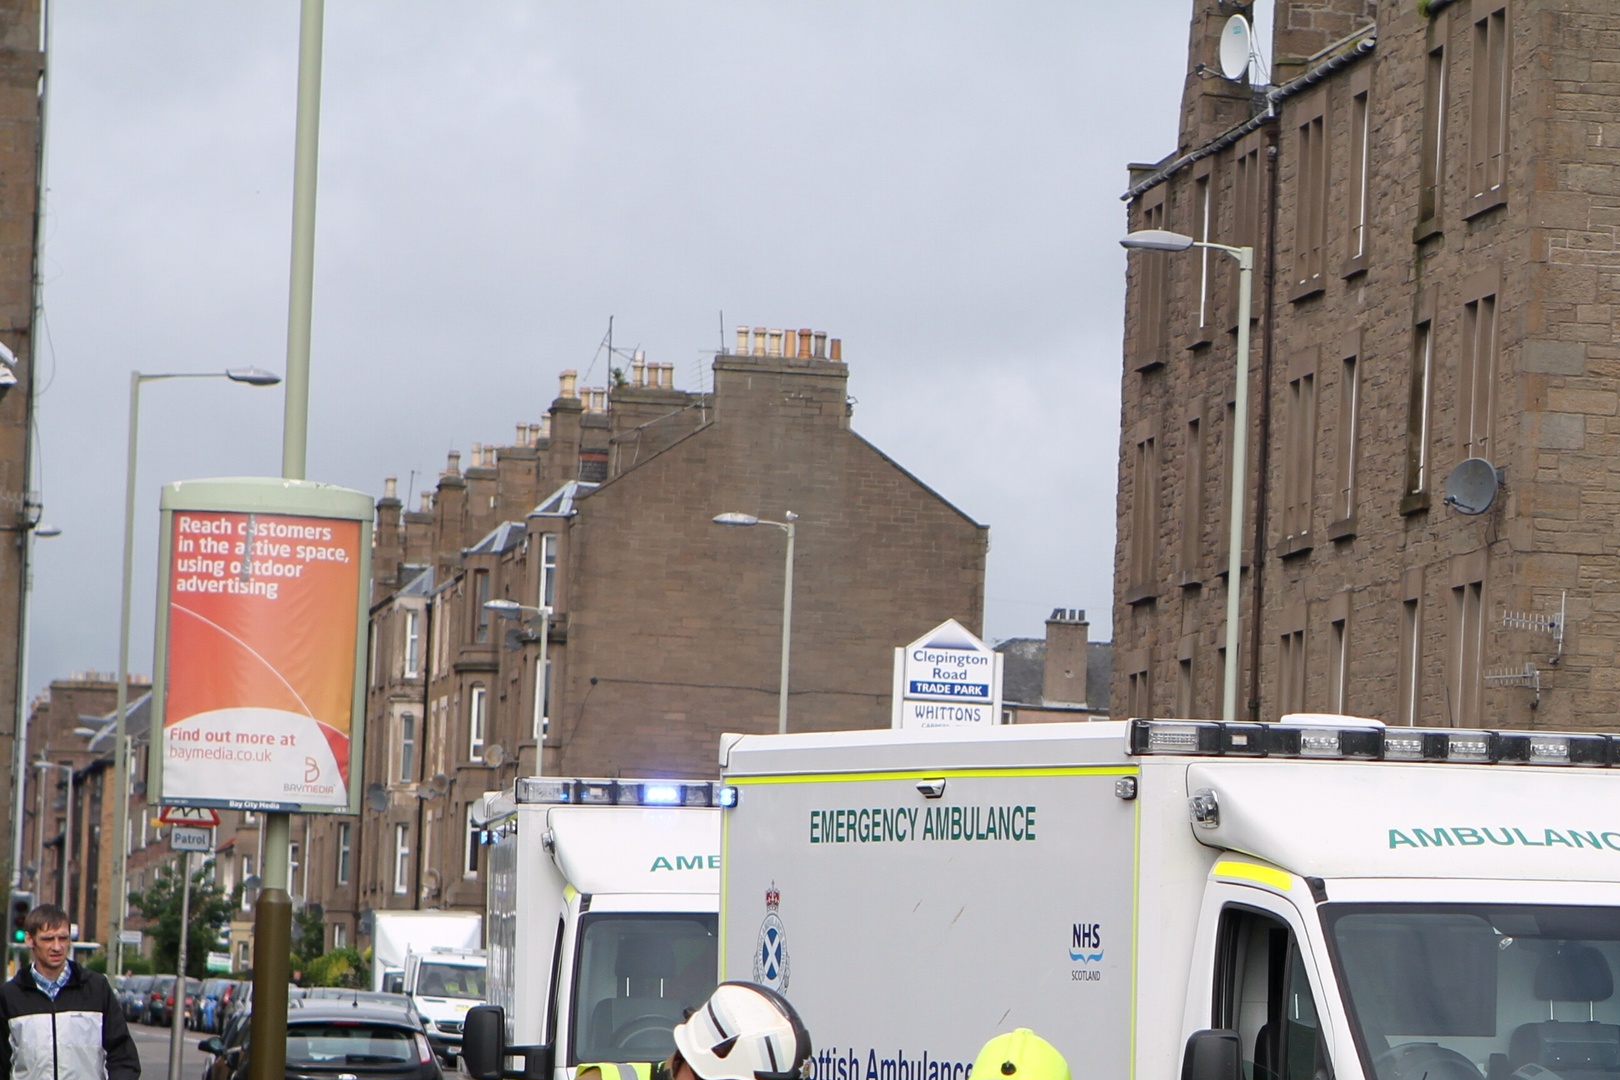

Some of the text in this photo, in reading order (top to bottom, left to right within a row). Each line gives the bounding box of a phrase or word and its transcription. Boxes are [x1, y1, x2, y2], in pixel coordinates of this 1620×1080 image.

[179, 516, 232, 535] Reach
[178, 536, 349, 563] in the ative space,
[177, 556, 225, 577] using
[176, 576, 278, 599] advertising
[913, 650, 988, 667] Clepington
[932, 667, 968, 681] Road
[916, 682, 982, 696] TRADE PARK
[915, 705, 981, 722] WHITTONS
[170, 728, 296, 747] Find out more at
[170, 745, 272, 762] baymedia.co.uk
[229, 800, 243, 809] Bay
[259, 801, 280, 810] Media
[810, 805, 1037, 843] EMERGENCY AMBULANCE
[175, 833, 206, 846] Patrol
[1072, 923, 1100, 949] NHS
[1071, 970, 1101, 981] SCOTLAND
